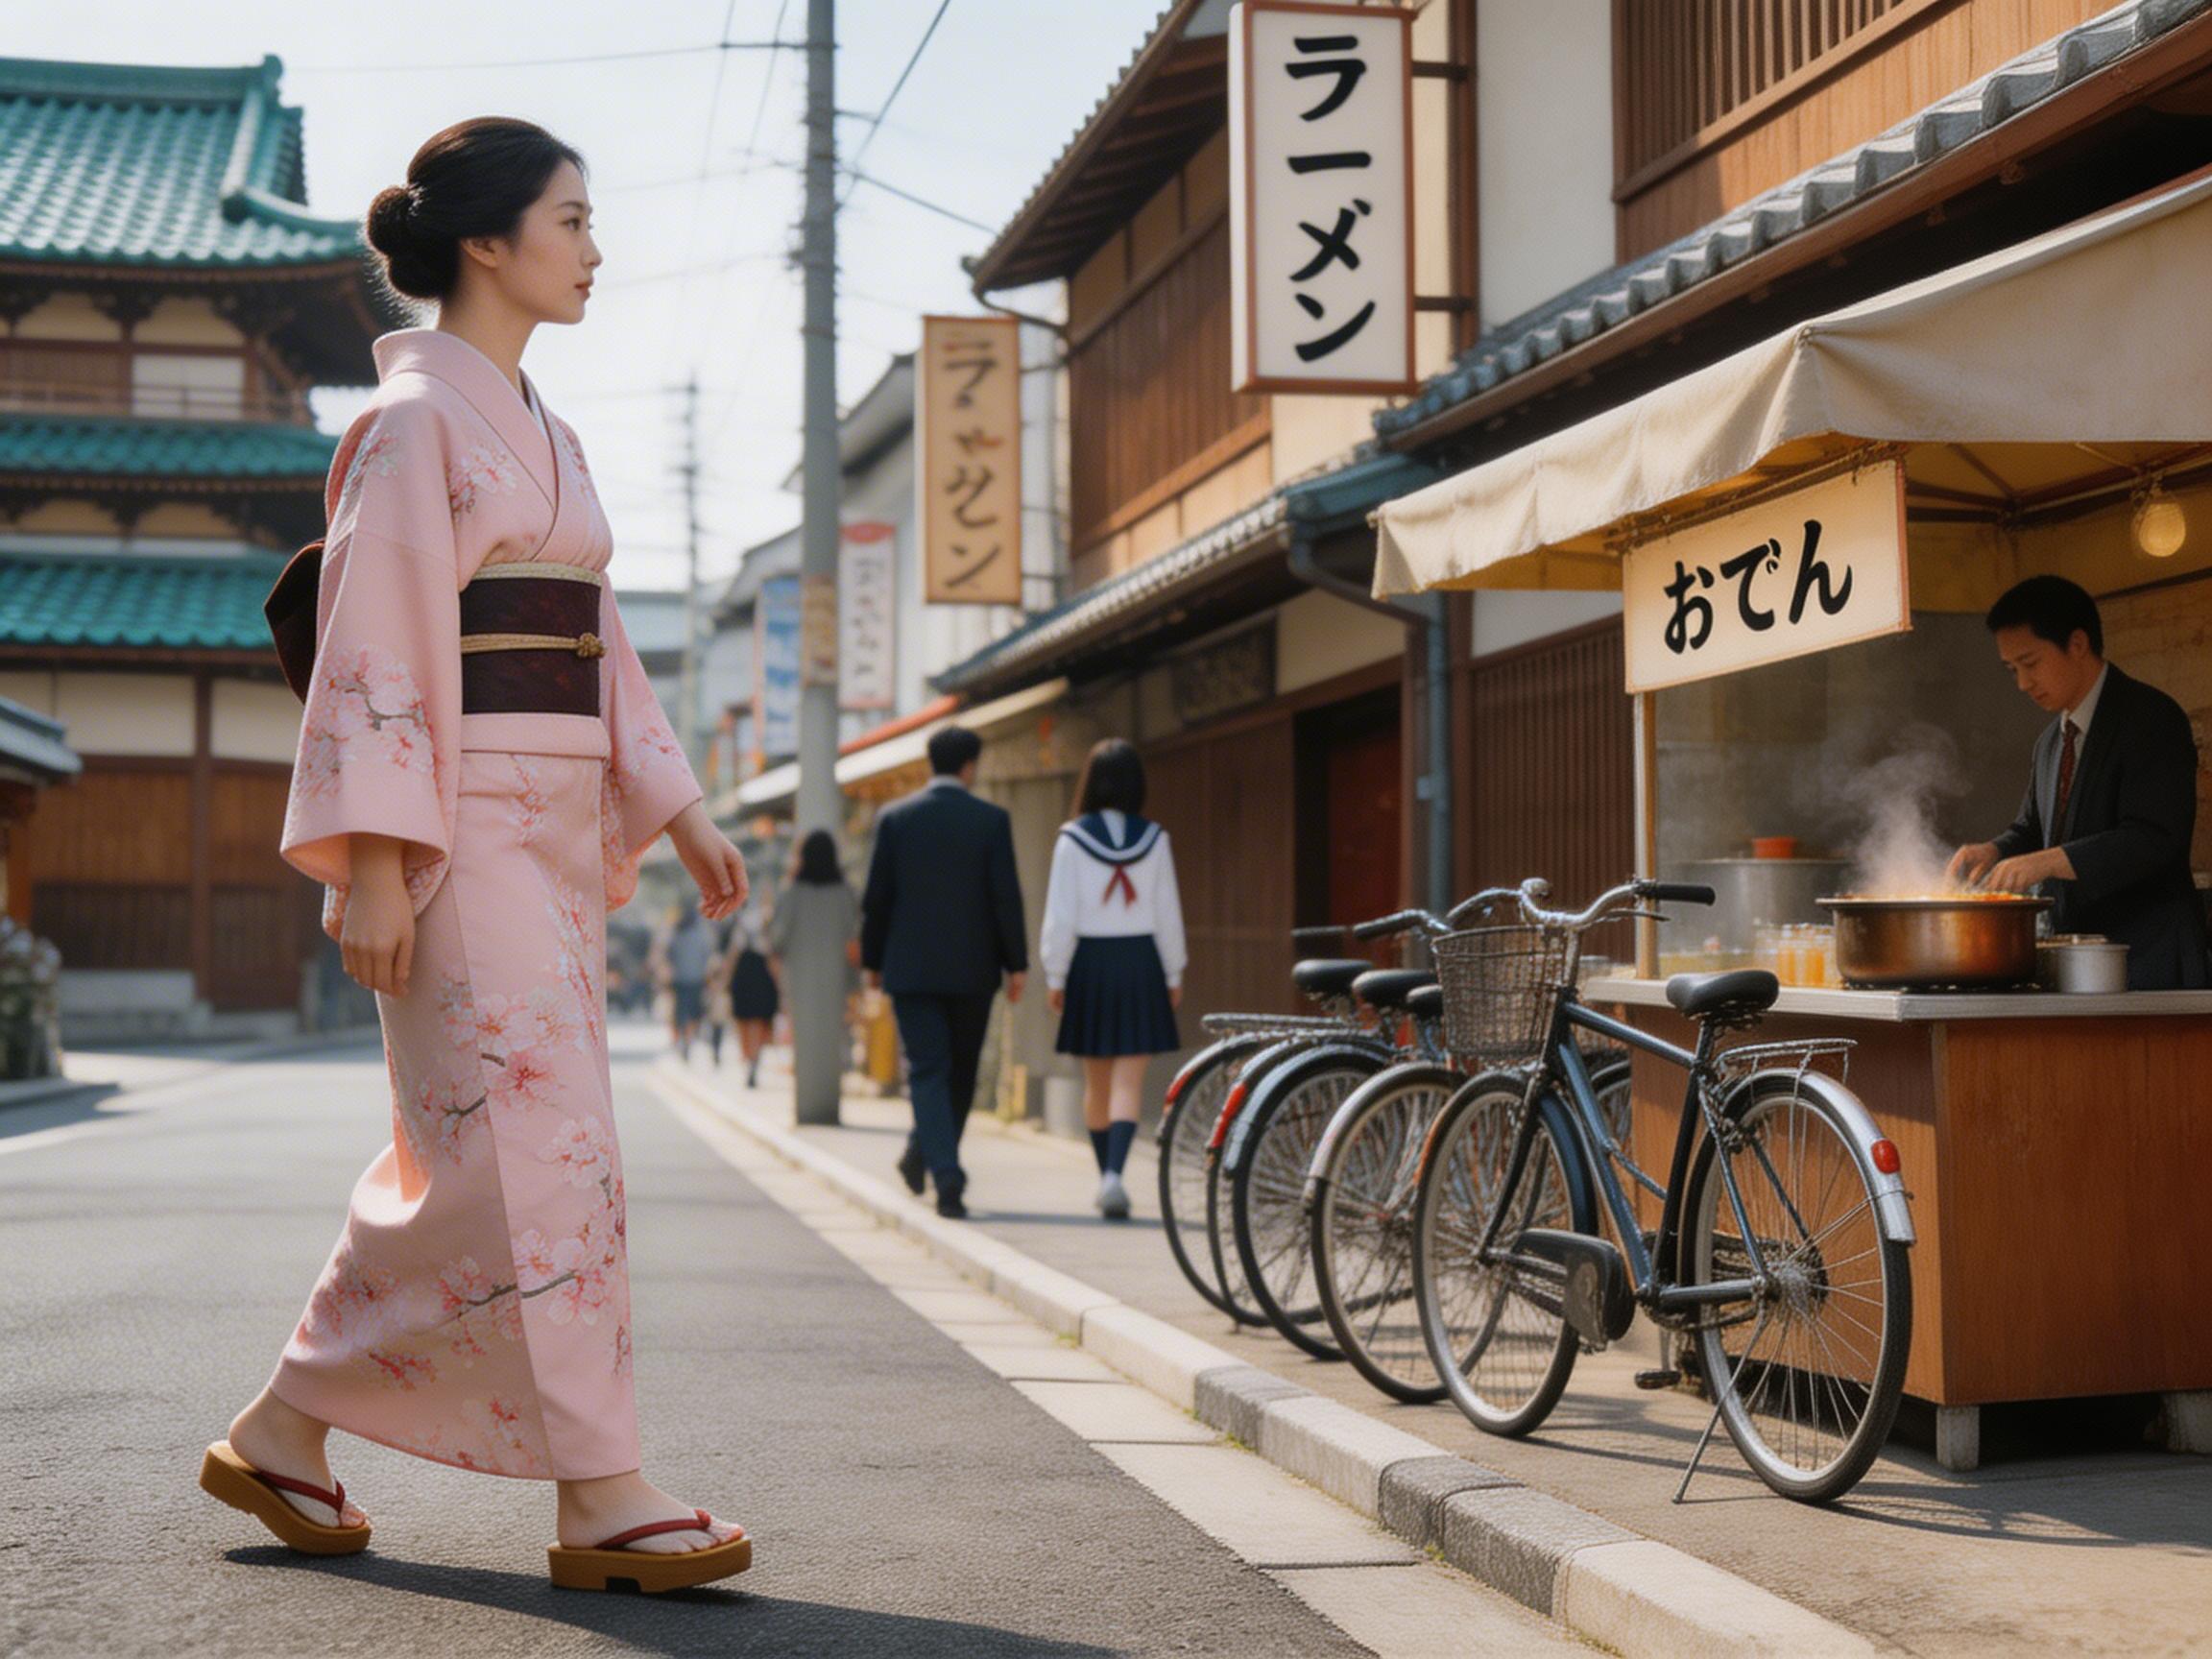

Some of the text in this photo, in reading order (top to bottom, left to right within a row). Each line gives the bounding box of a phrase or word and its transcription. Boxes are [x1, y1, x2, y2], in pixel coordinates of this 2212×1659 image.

[1285, 35, 1376, 362] ラーメン
[1663, 519, 1853, 655] おでん
